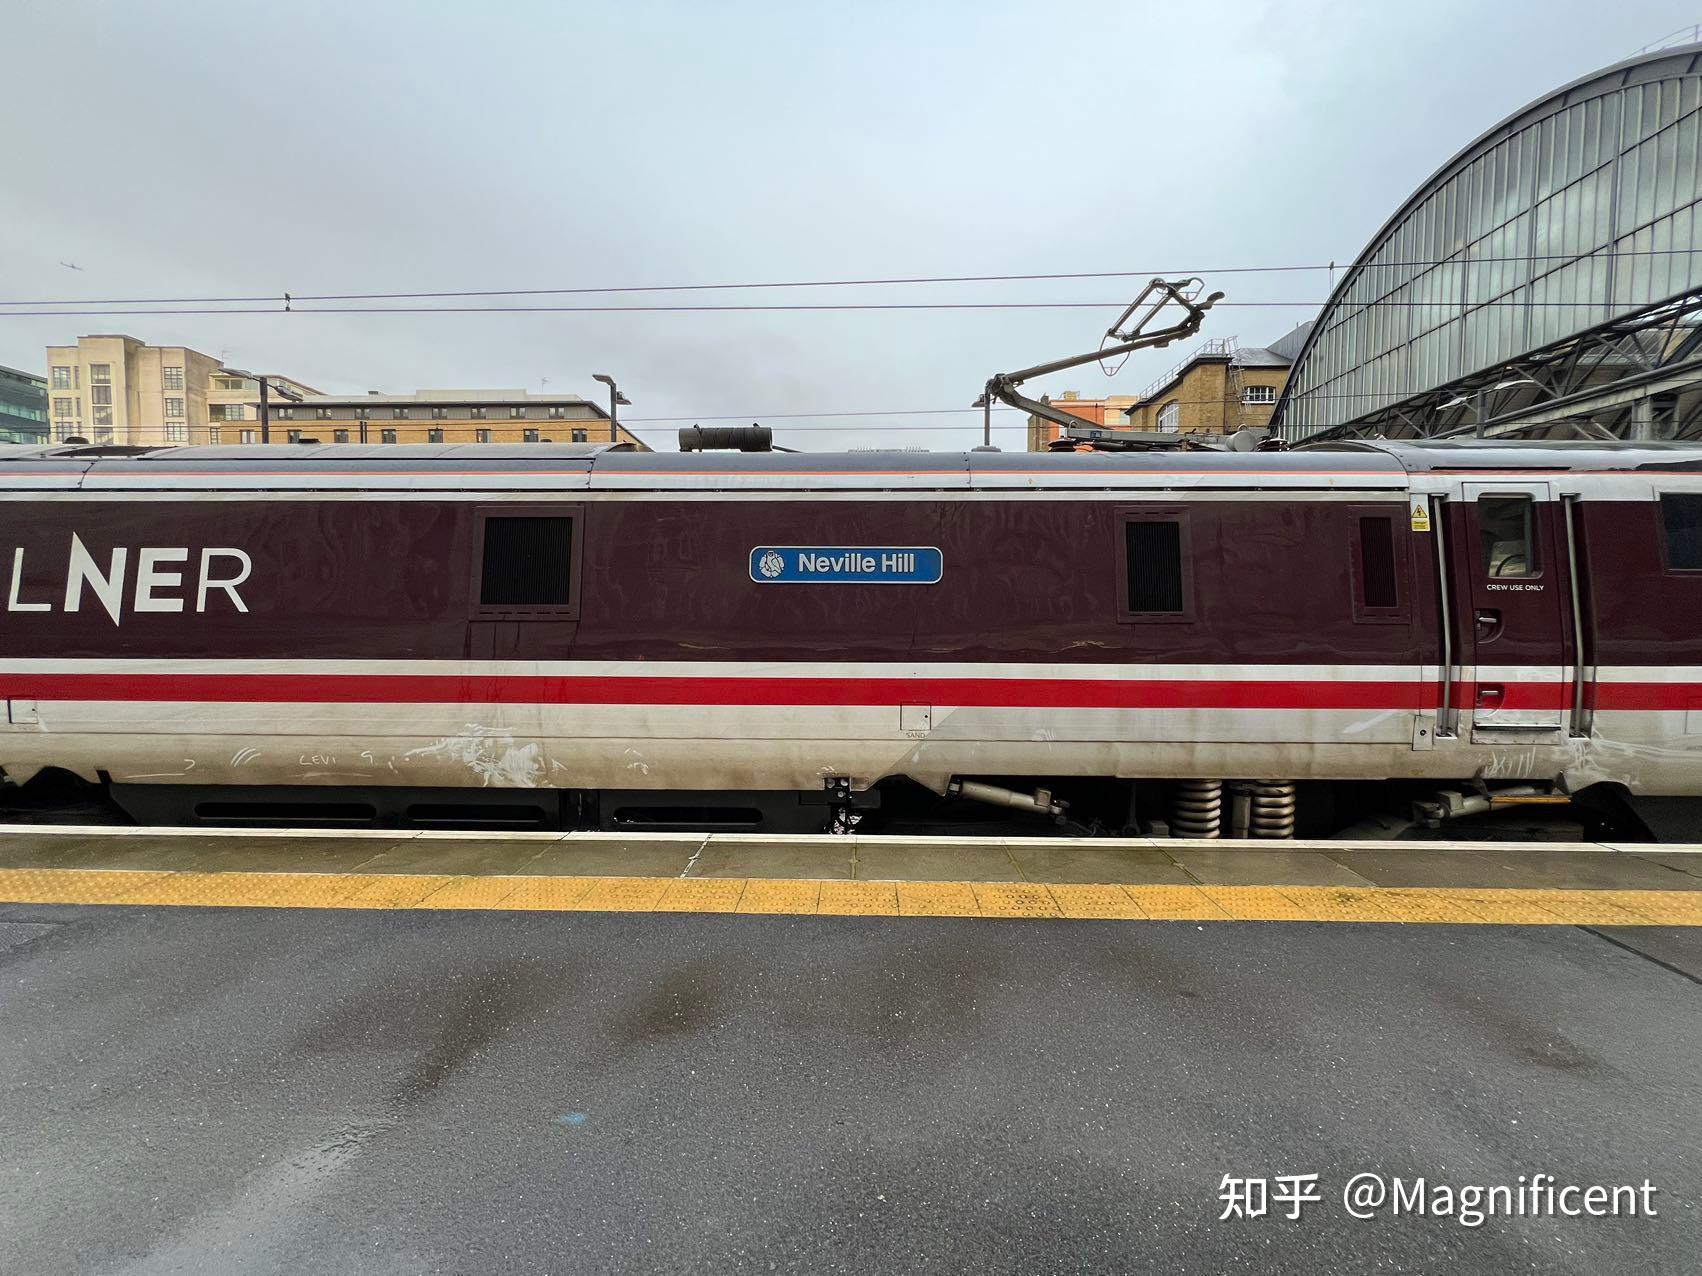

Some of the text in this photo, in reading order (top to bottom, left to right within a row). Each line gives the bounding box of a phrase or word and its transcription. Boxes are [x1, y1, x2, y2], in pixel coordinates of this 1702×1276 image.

[798, 553, 915, 573] Neville Hill
[8, 531, 252, 627] LNER
[299, 755, 336, 765] LEVI
